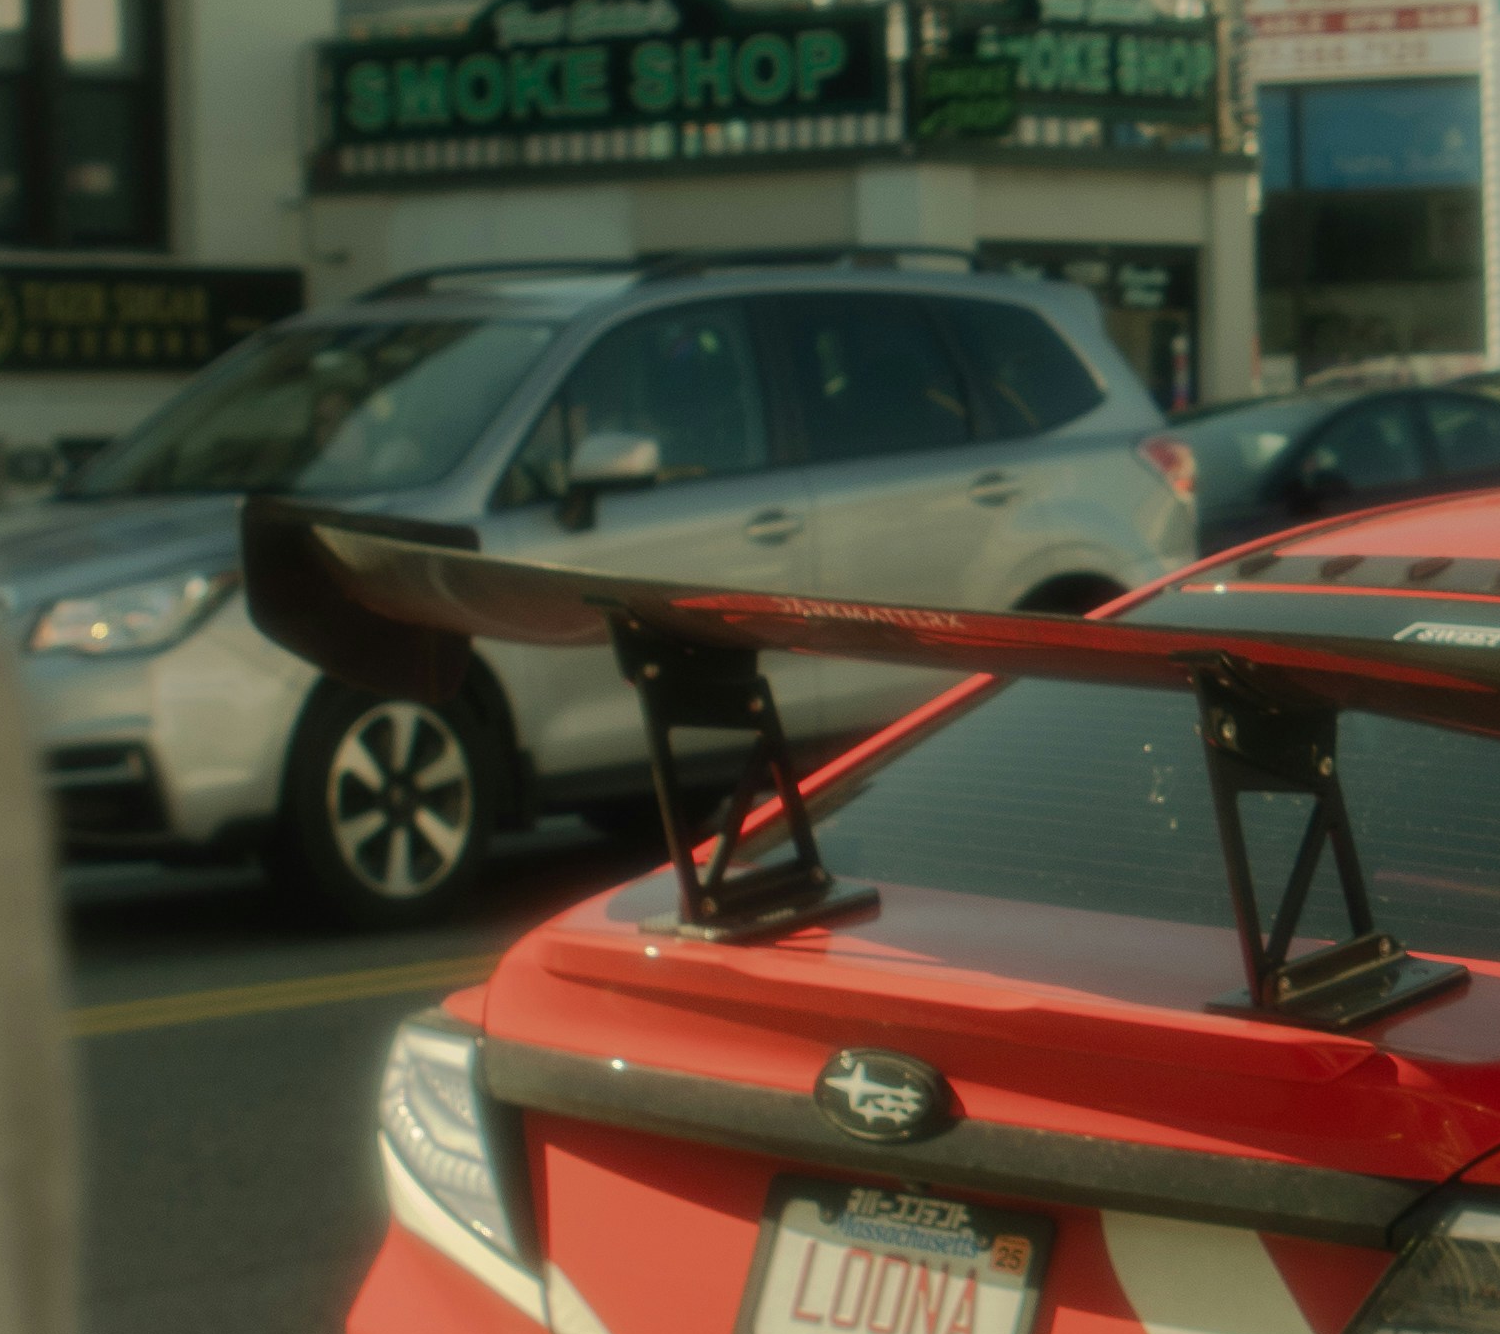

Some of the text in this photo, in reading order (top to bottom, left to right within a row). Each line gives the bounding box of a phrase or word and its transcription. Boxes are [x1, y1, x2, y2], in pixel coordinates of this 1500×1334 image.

[346, 47, 609, 131] SMOKE
[630, 30, 845, 110] SHOP
[994, 1245, 1021, 1271] 25
